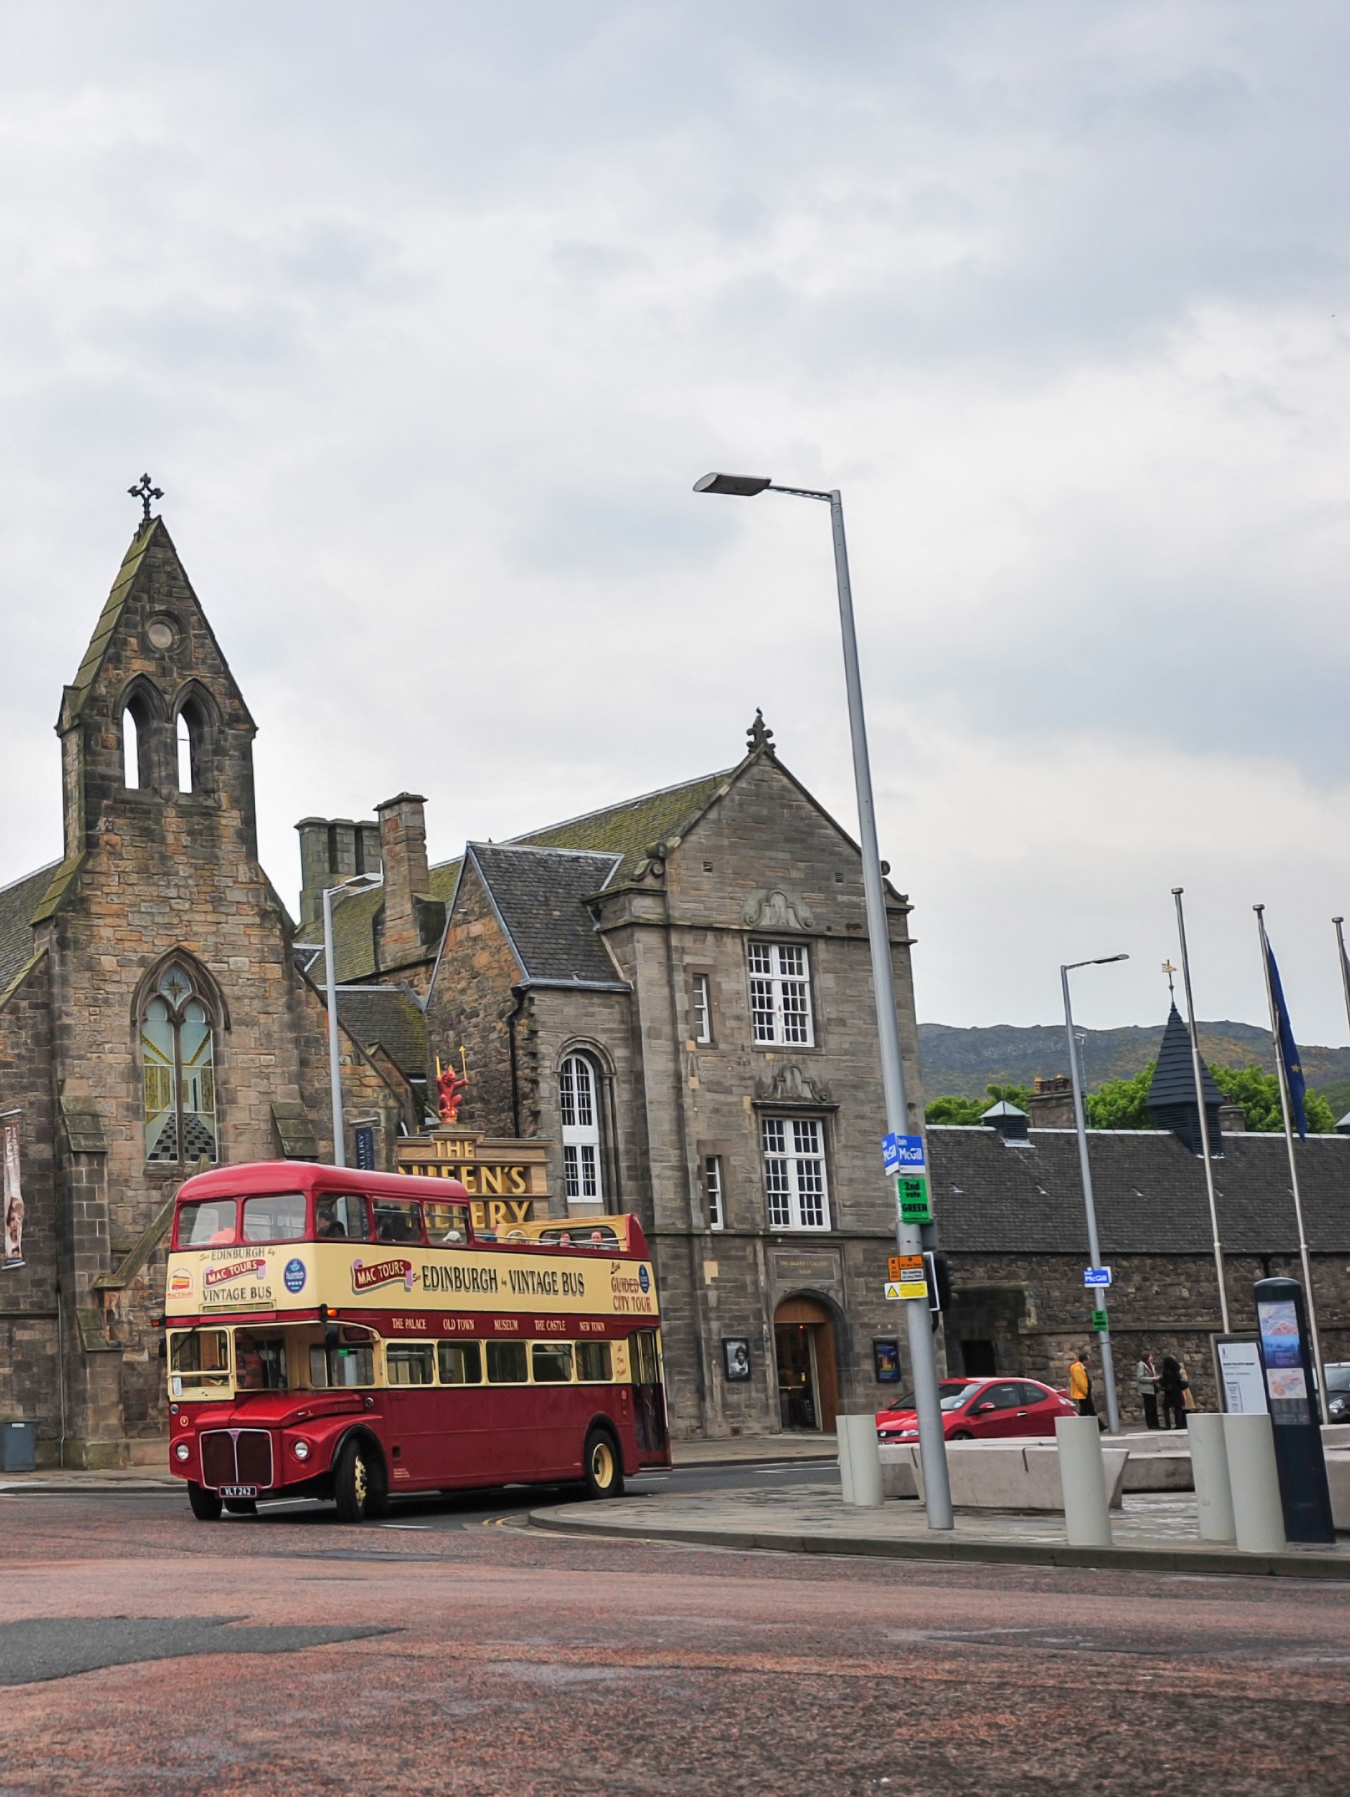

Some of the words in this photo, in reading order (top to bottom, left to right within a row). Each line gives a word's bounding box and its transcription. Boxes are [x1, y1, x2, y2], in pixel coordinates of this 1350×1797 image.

[434, 1140, 474, 1158] THE
[900, 1148, 922, 1160] McGill
[398, 1165, 526, 1194] EEN'S
[905, 1182, 920, 1190] 2nd
[902, 1204, 928, 1212] GREEN
[211, 1248, 264, 1260] EDINBURGH
[208, 1270, 226, 1283] MAC
[229, 1260, 258, 1275] TOURS
[358, 1268, 376, 1284] MAC
[378, 1262, 404, 1278] TOURS
[422, 1265, 498, 1293] EDINBURGH
[509, 1270, 559, 1295] VINTAGE
[562, 1272, 584, 1296] BUS
[611, 1277, 639, 1294] GUIDED
[202, 1288, 246, 1302] VINTAGE
[250, 1286, 272, 1300] BUS
[614, 1295, 630, 1312] CITY
[632, 1296, 652, 1312] TOUR
[392, 1318, 404, 1329] THE
[405, 1319, 426, 1330] PALACE
[443, 1319, 456, 1330] OLD
[457, 1320, 474, 1330] TOWN
[494, 1320, 518, 1330] MUSEUM
[534, 1320, 546, 1330] THE
[546, 1320, 566, 1332] CASTLE
[580, 1322, 590, 1331] NEW
[591, 1322, 606, 1332] TOWN
[238, 1488, 250, 1496] 242
